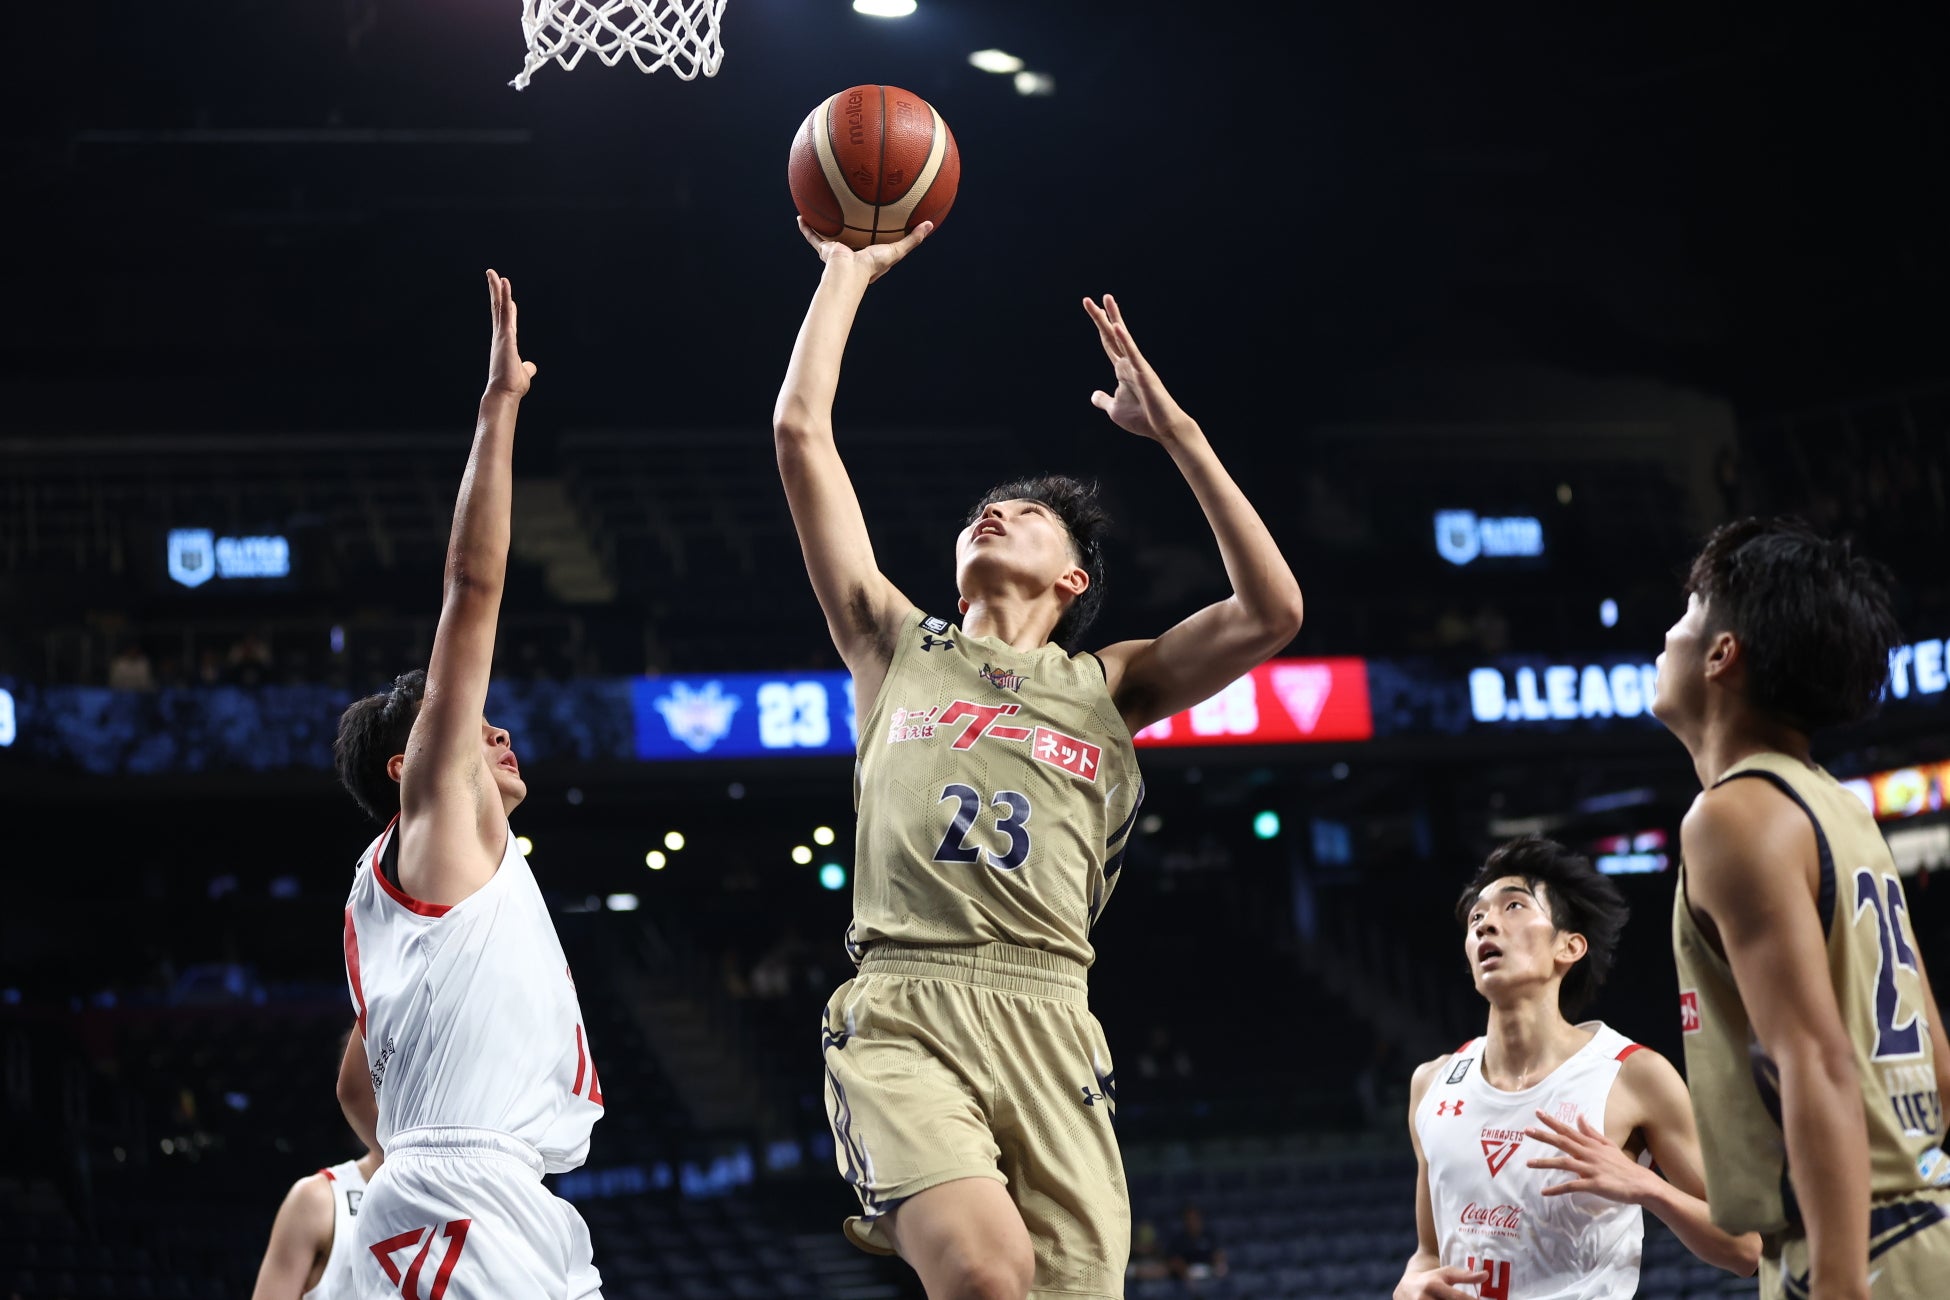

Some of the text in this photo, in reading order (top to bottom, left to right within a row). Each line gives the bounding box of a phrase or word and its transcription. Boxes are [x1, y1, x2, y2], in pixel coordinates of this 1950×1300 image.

[846, 90, 864, 144] molten
[757, 681, 830, 748] 23
[1037, 734, 1095, 773] ネット
[932, 783, 1032, 871] 23
